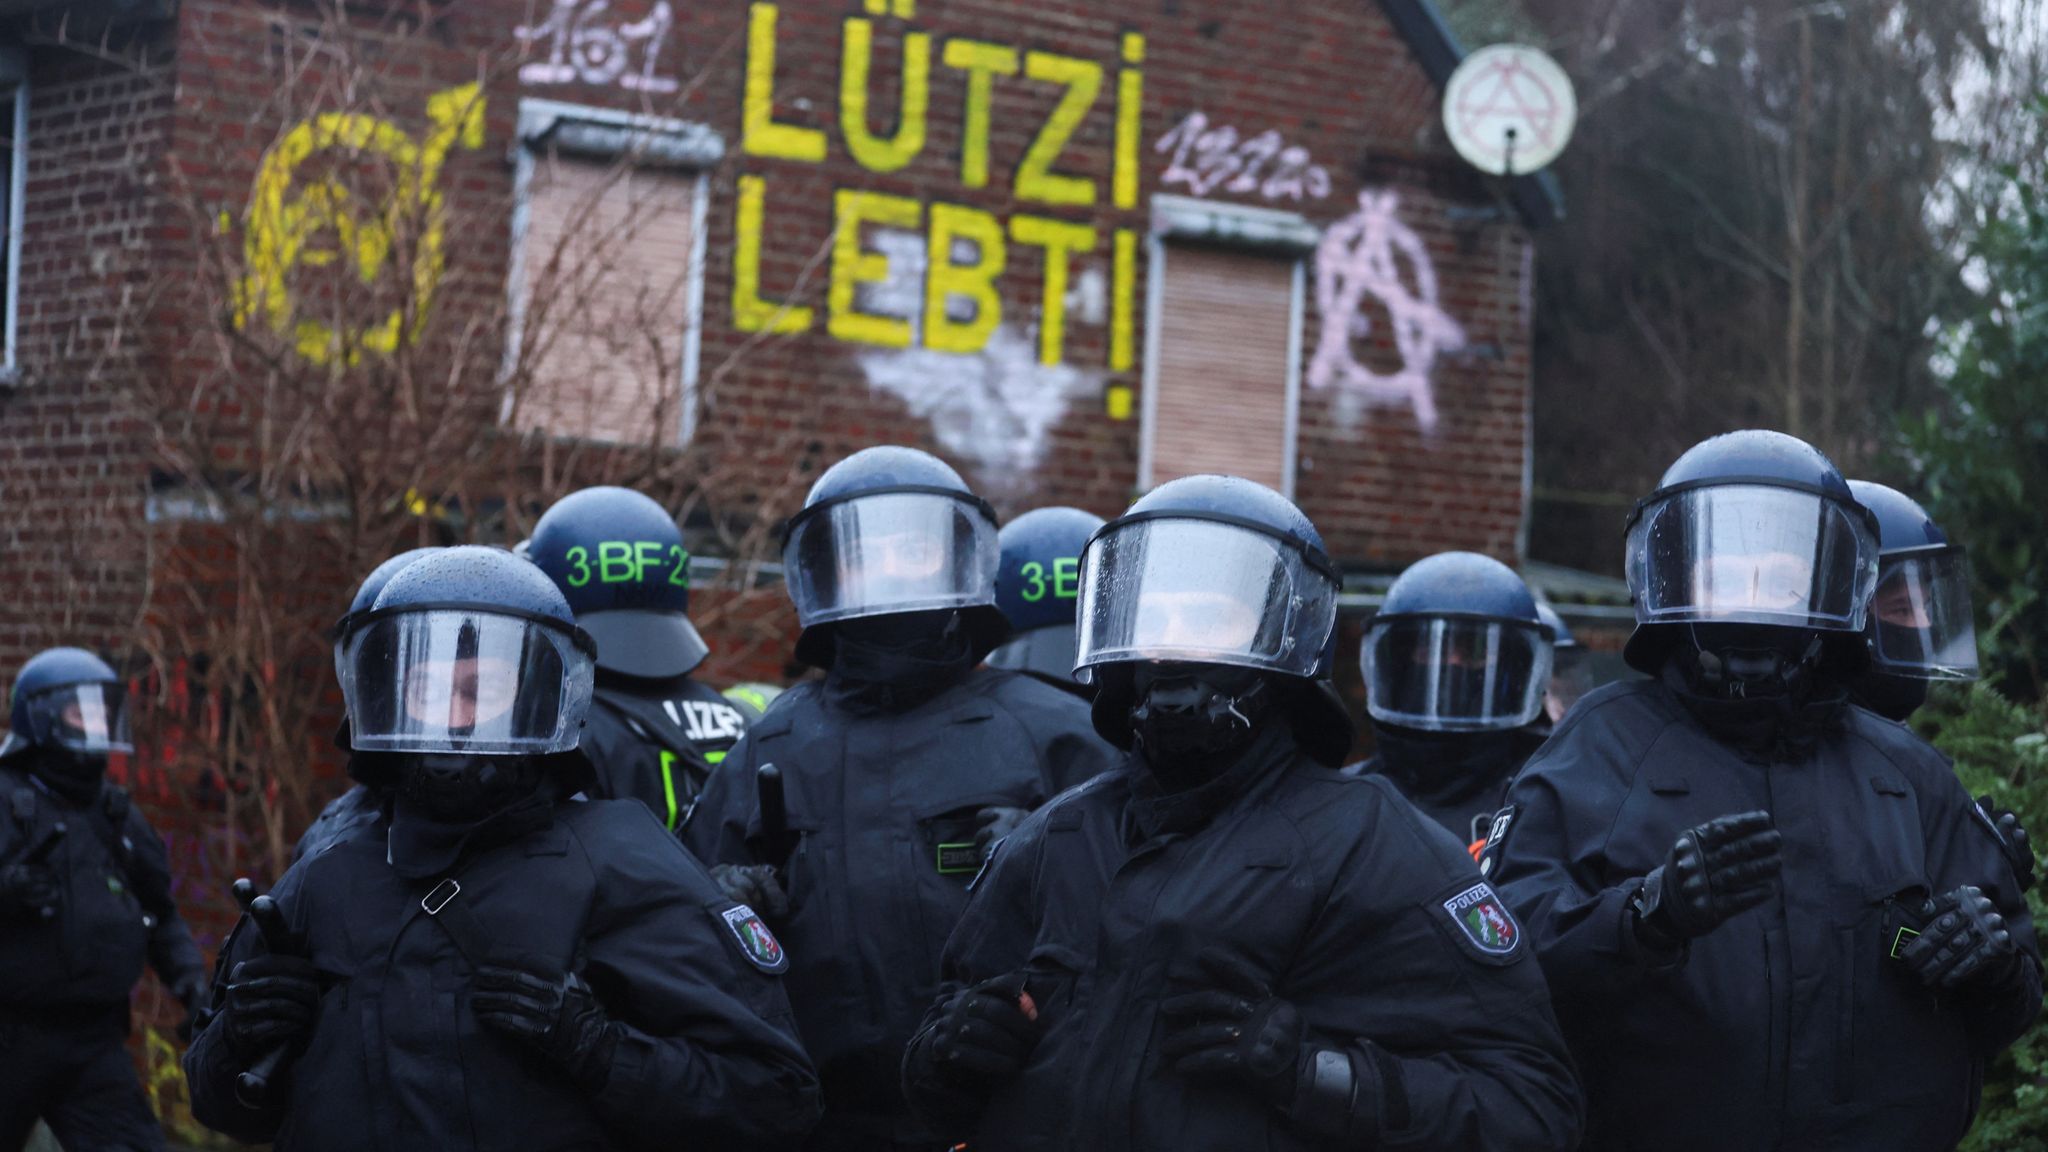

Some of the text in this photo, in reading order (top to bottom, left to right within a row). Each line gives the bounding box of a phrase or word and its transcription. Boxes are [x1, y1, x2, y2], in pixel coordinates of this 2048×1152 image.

[513, 0, 679, 92] 161
[732, 174, 1137, 421] LEBT!
[565, 540, 689, 589] 3-BF-2
